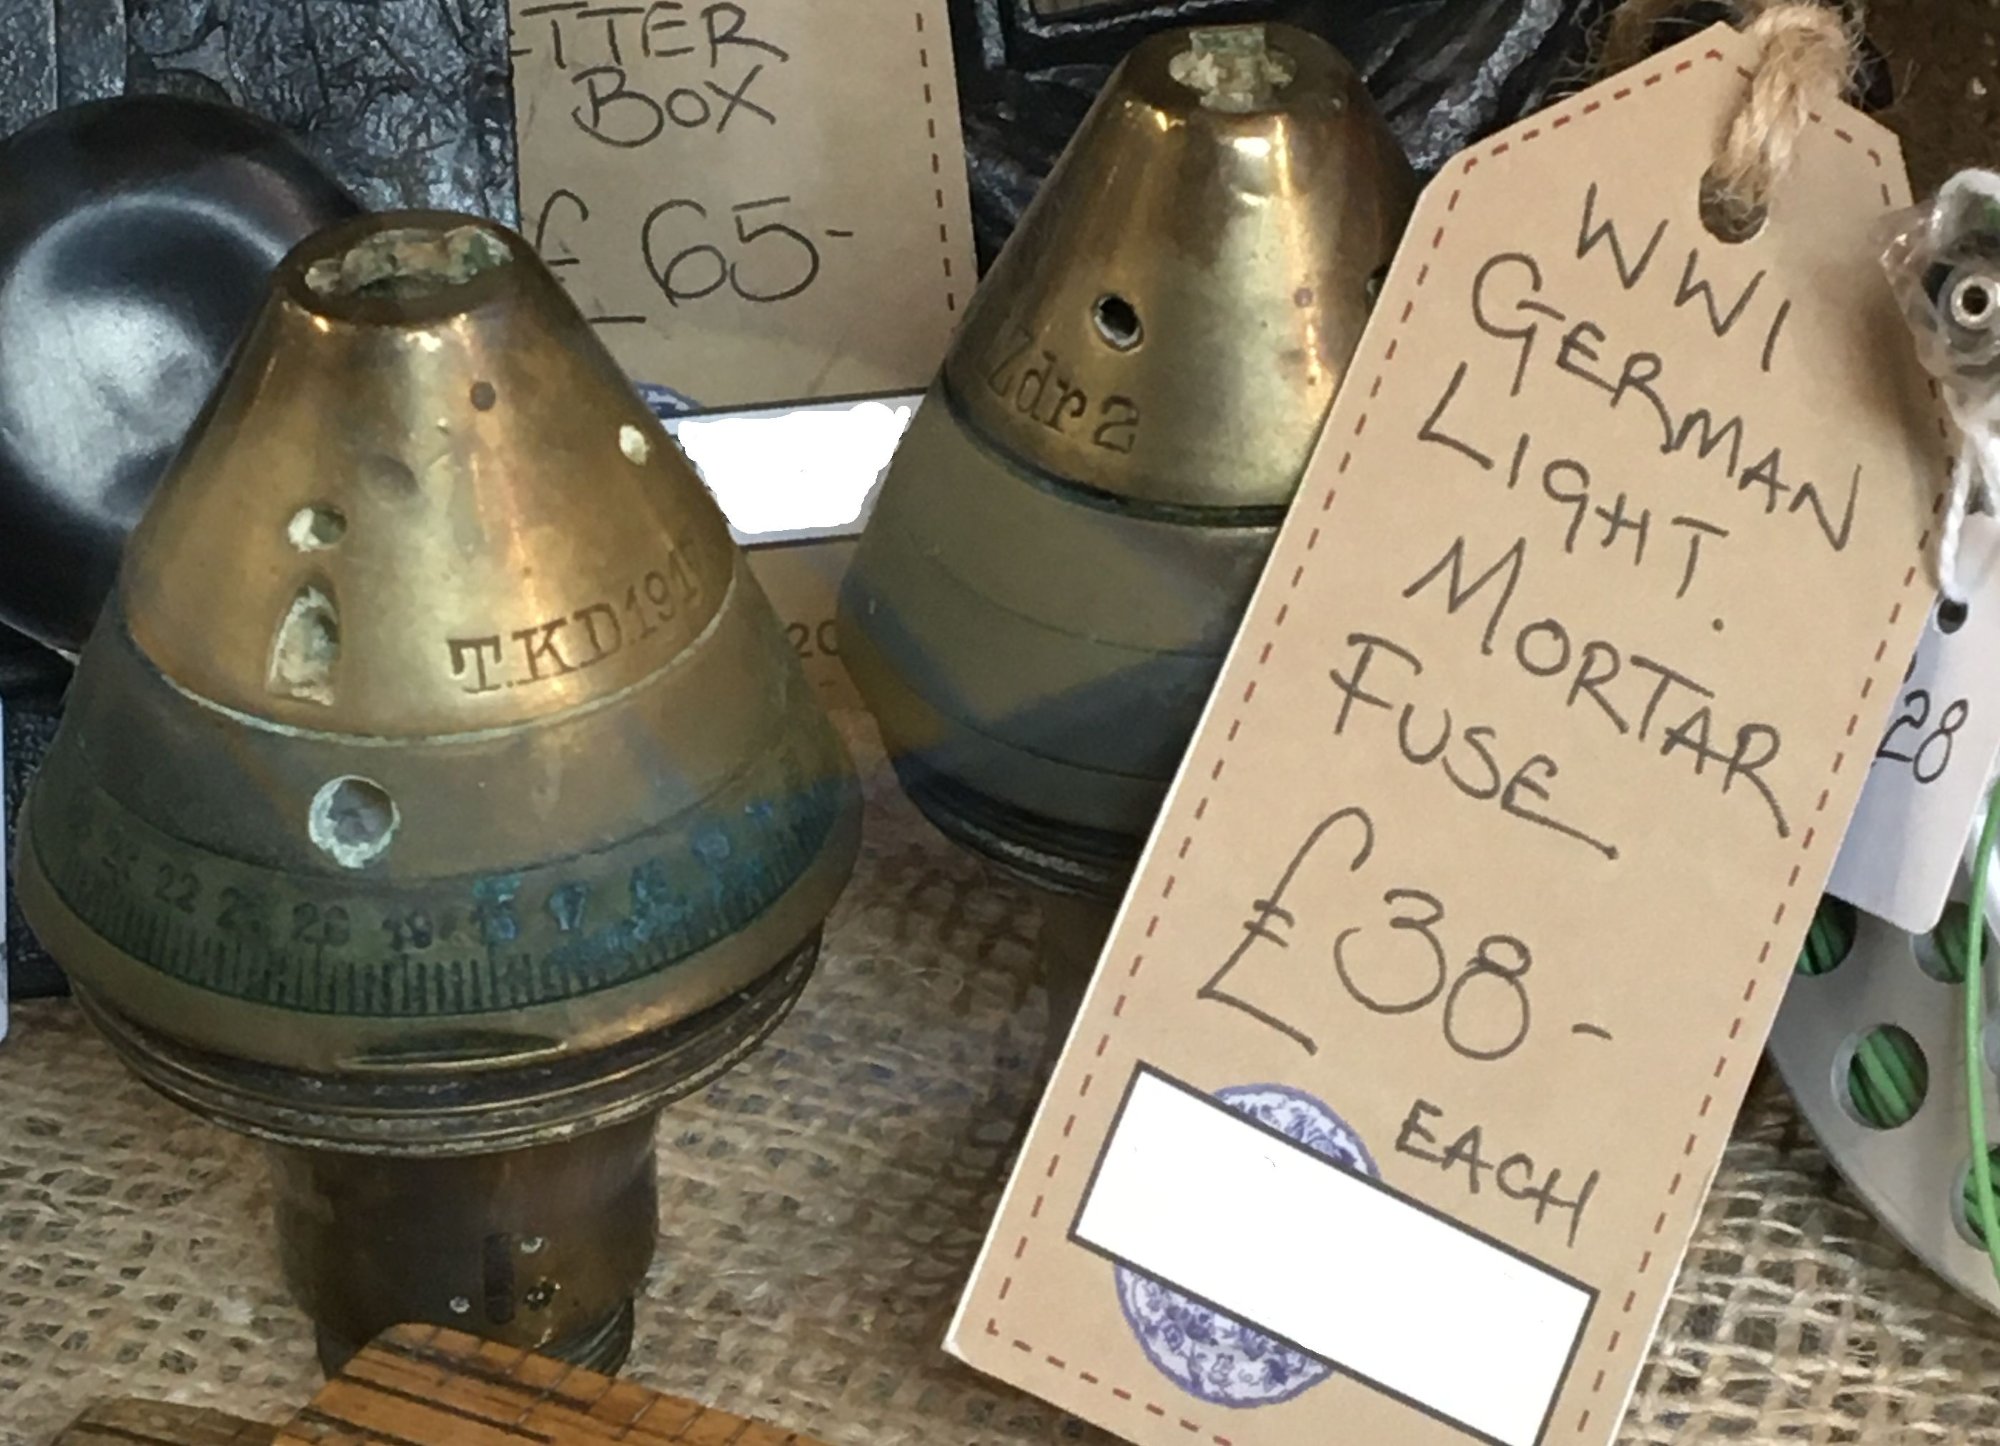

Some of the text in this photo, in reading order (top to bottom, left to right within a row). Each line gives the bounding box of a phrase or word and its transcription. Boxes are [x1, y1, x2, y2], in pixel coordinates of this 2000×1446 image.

[571, 65, 777, 148] BOX
[1576, 182, 1792, 372] WWI
[1471, 252, 1863, 552] GERMAN
[1328, 632, 1621, 861] FUSE
[1402, 536, 1790, 839] MORTAR
[1871, 651, 1969, 784] 28
[1394, 1098, 1600, 1248] EACH
